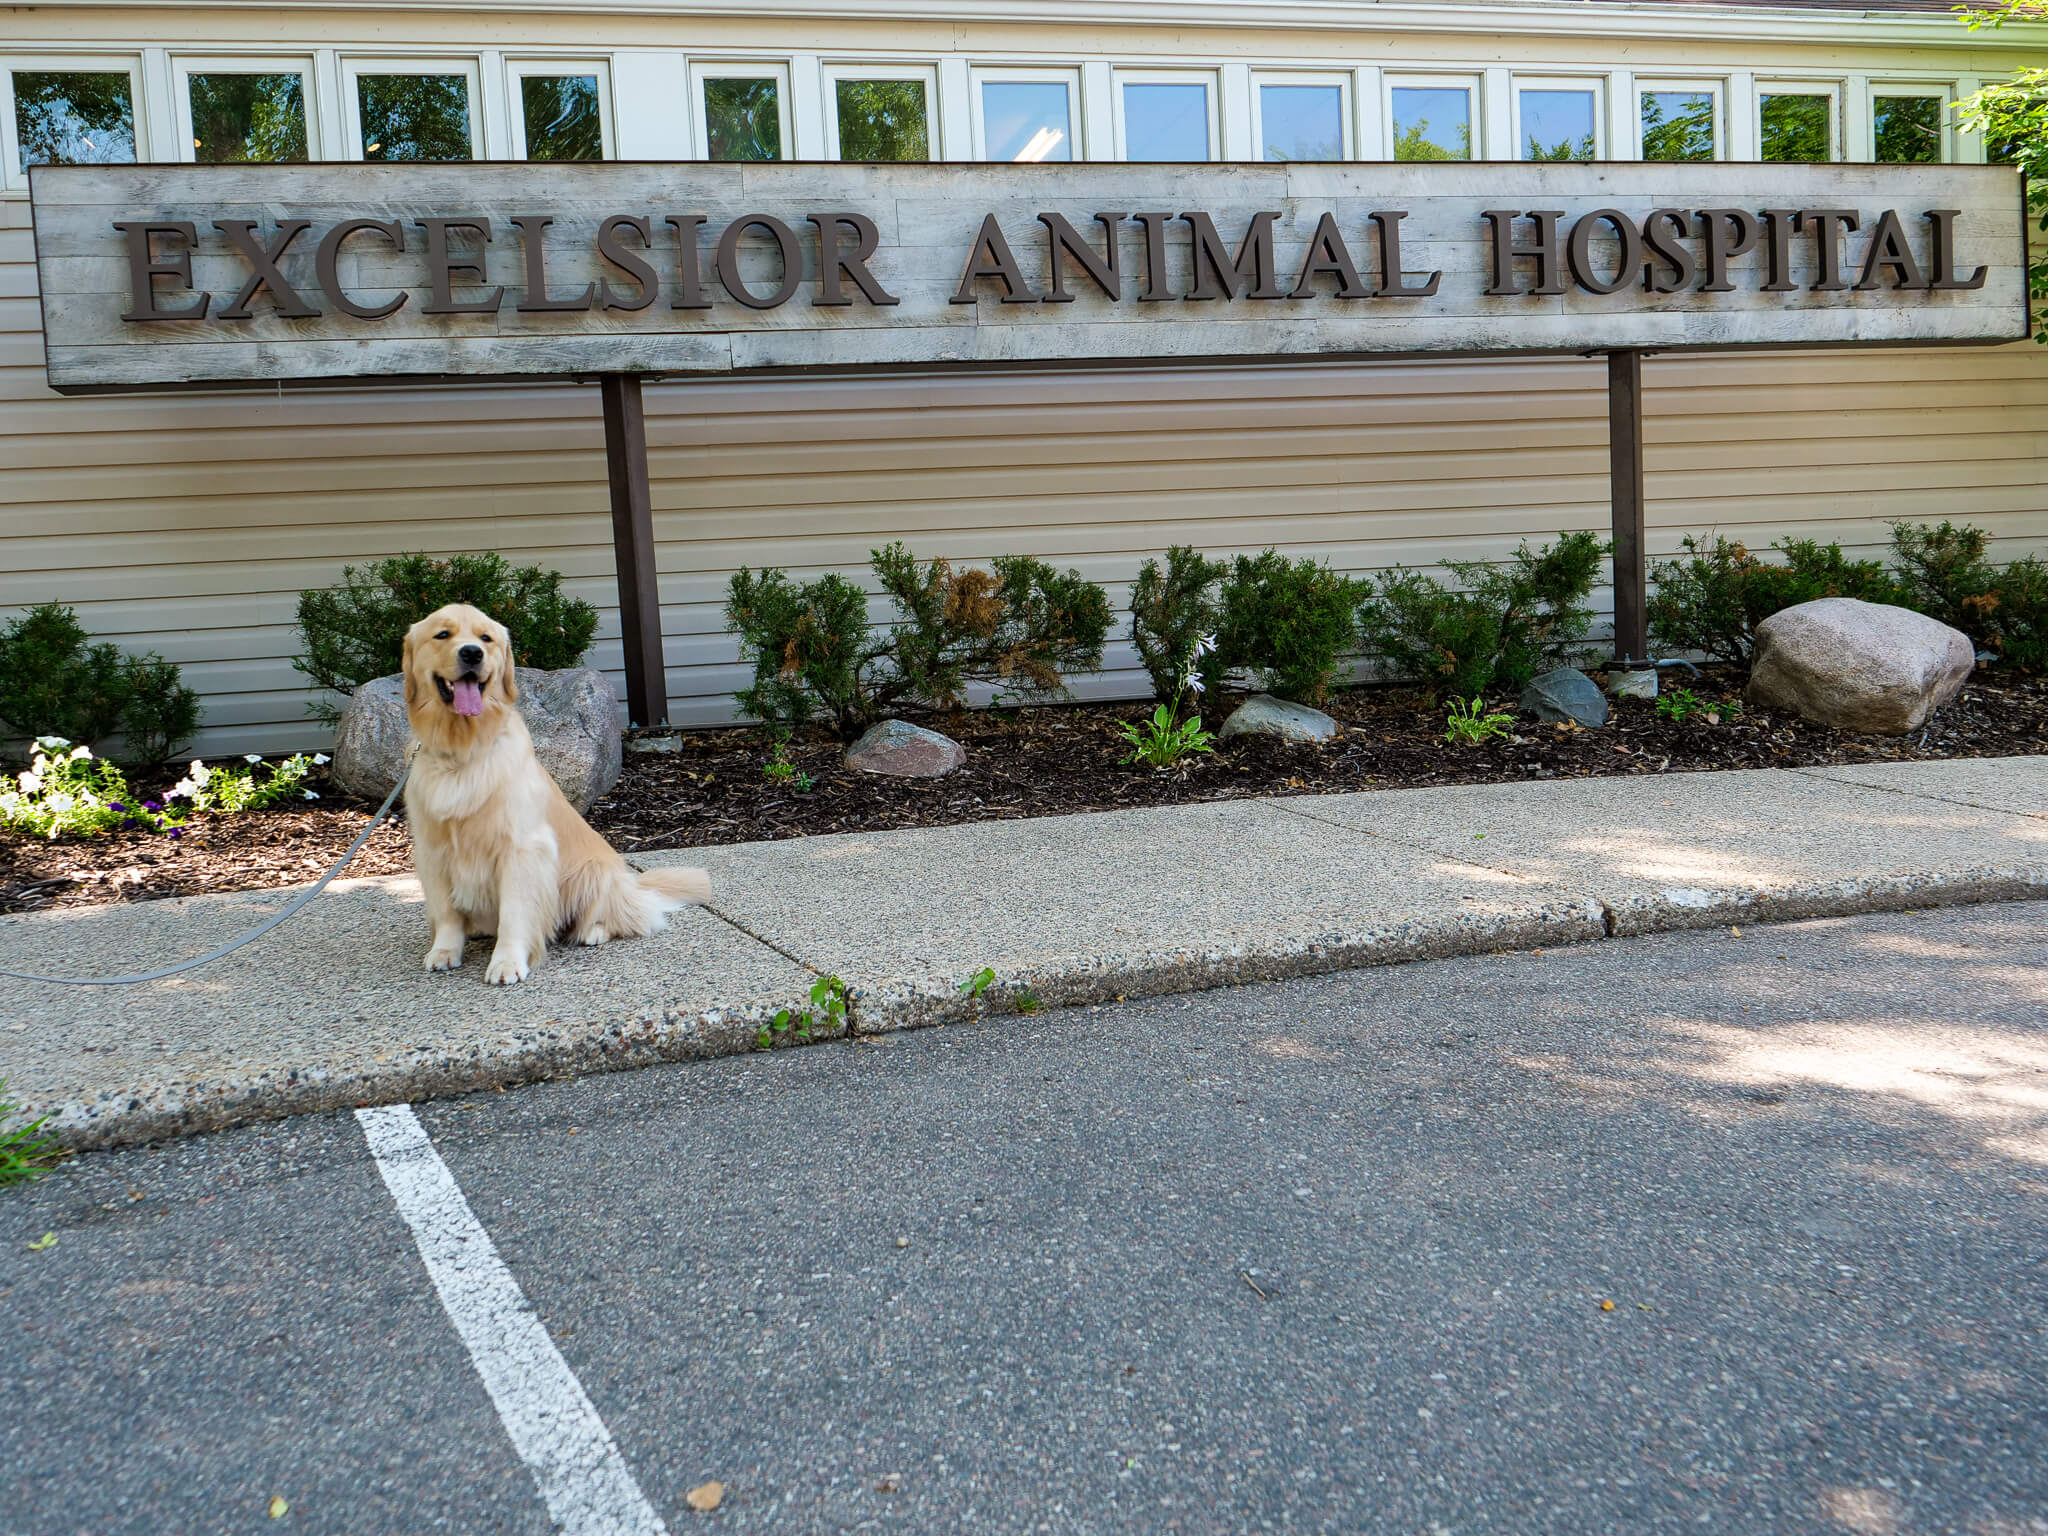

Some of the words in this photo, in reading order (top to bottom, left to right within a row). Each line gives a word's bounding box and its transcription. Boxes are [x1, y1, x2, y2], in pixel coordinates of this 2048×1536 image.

[113, 212, 900, 321] EXCELSIOR
[949, 210, 1441, 304] ANIMAL
[1481, 208, 1987, 295] HOSPITAL
